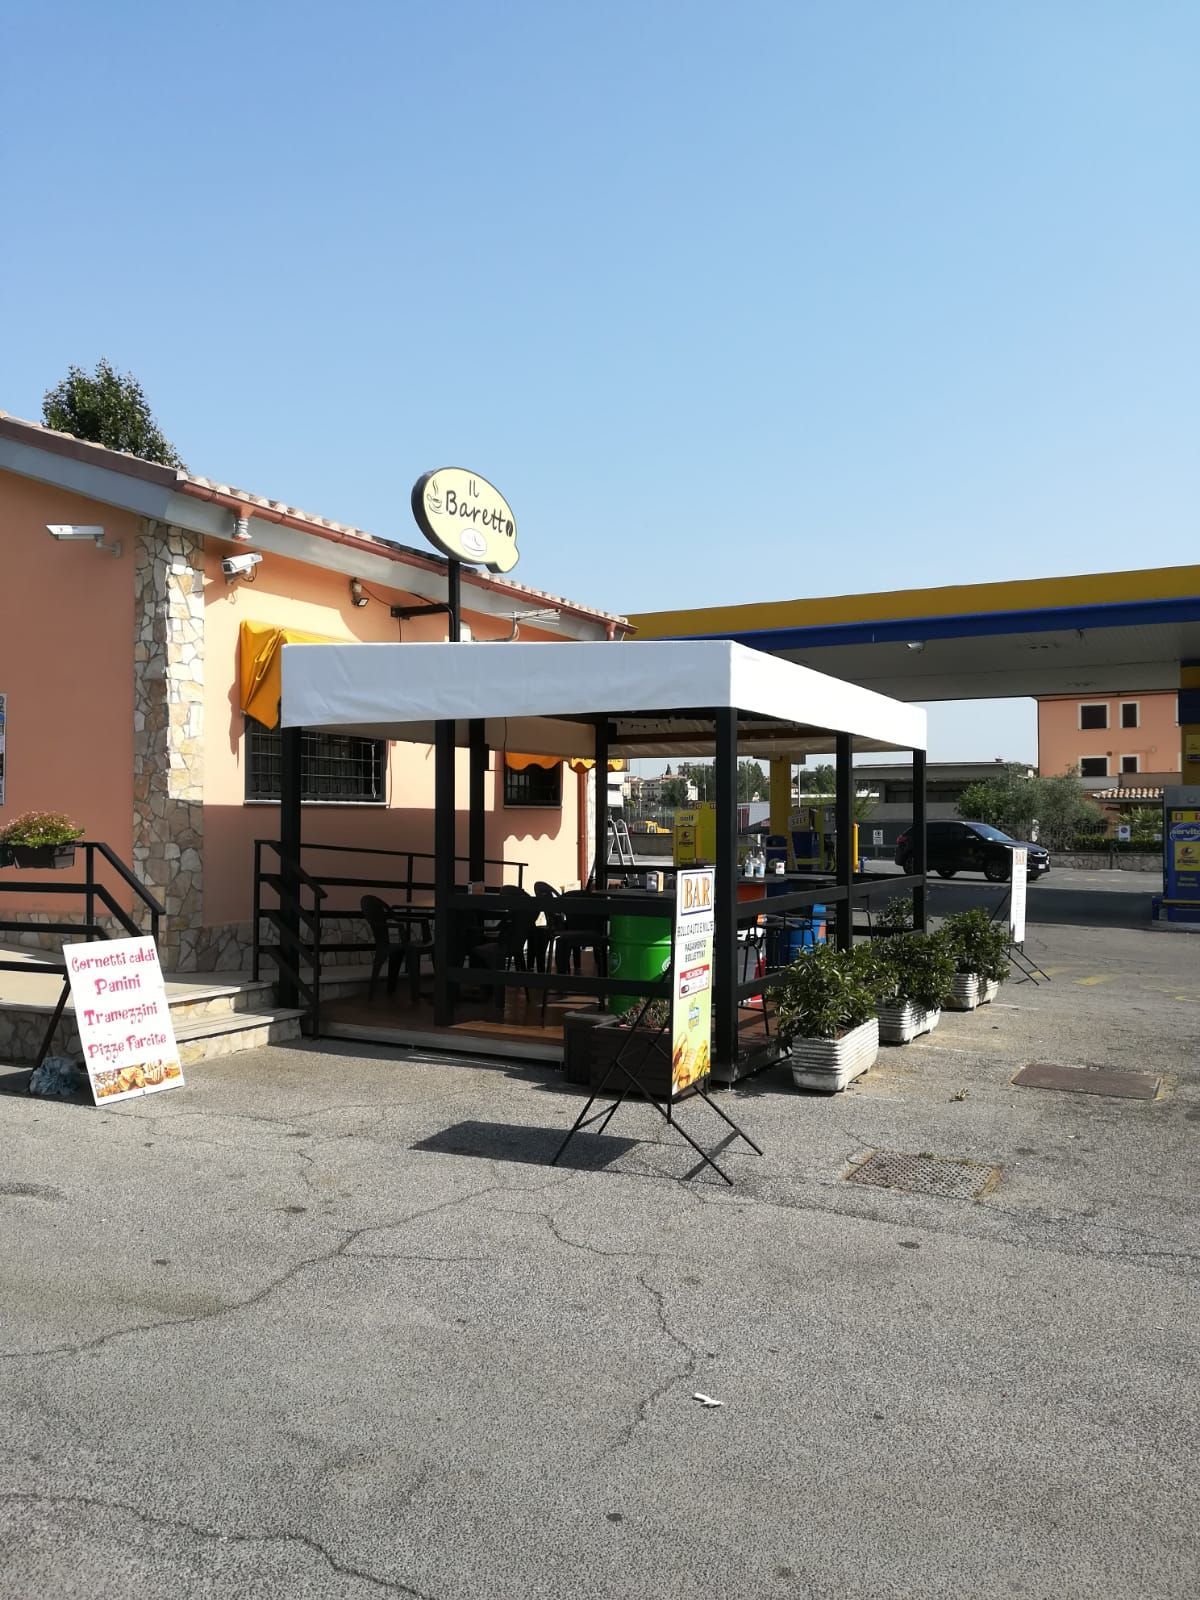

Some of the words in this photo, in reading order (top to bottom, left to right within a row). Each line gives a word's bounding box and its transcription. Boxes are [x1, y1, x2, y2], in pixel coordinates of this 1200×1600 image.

[445, 490, 514, 537] Baretto
[684, 876, 711, 909] BAR
[71, 952, 127, 973] Cornetti
[129, 947, 156, 963] caldi
[94, 974, 141, 995] Panini
[84, 1002, 158, 1026] Tramezzini
[88, 1040, 125, 1061] Pizze
[126, 1032, 167, 1052] Farcite
